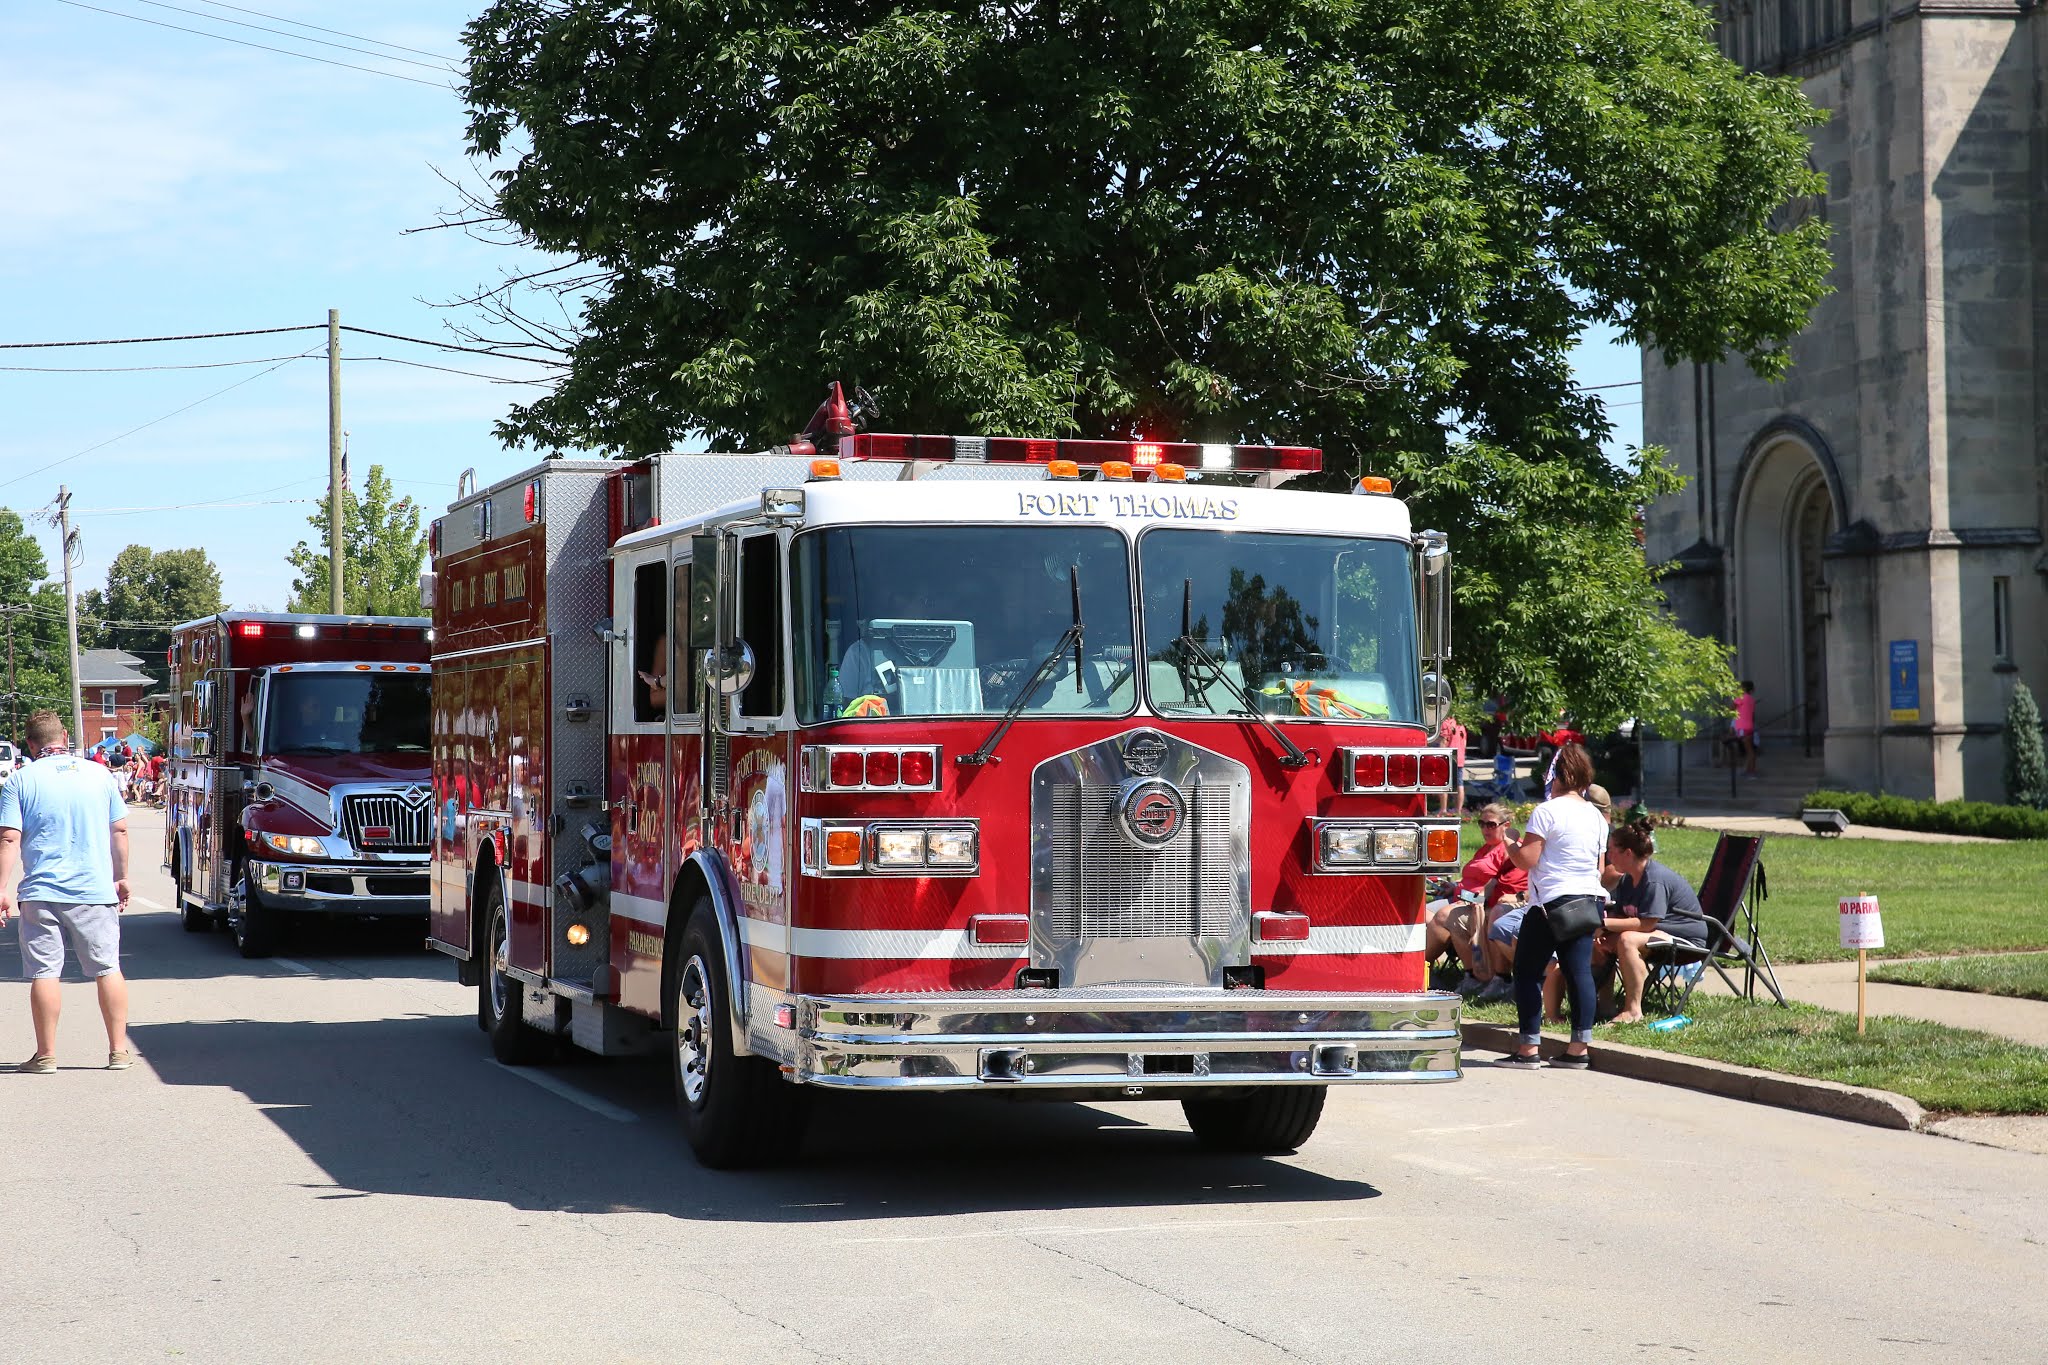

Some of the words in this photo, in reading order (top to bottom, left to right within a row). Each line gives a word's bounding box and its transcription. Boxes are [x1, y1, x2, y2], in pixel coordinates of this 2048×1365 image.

[1018, 492, 1099, 517] FORT
[1110, 494, 1240, 520] THOMAS
[452, 579, 463, 613] CITY
[469, 575, 477, 609] OF
[484, 571, 498, 605] FORT
[503, 563, 527, 601] THOMAS
[636, 762, 663, 793] ENGINE
[736, 750, 754, 784] FORT
[640, 810, 657, 843] 602
[740, 882, 756, 903] FIRE
[759, 884, 781, 907] DEPT.
[1839, 902, 1849, 915] NO
[1850, 902, 1880, 915] PARKIN
[628, 930, 664, 961] PARAMEDICS
